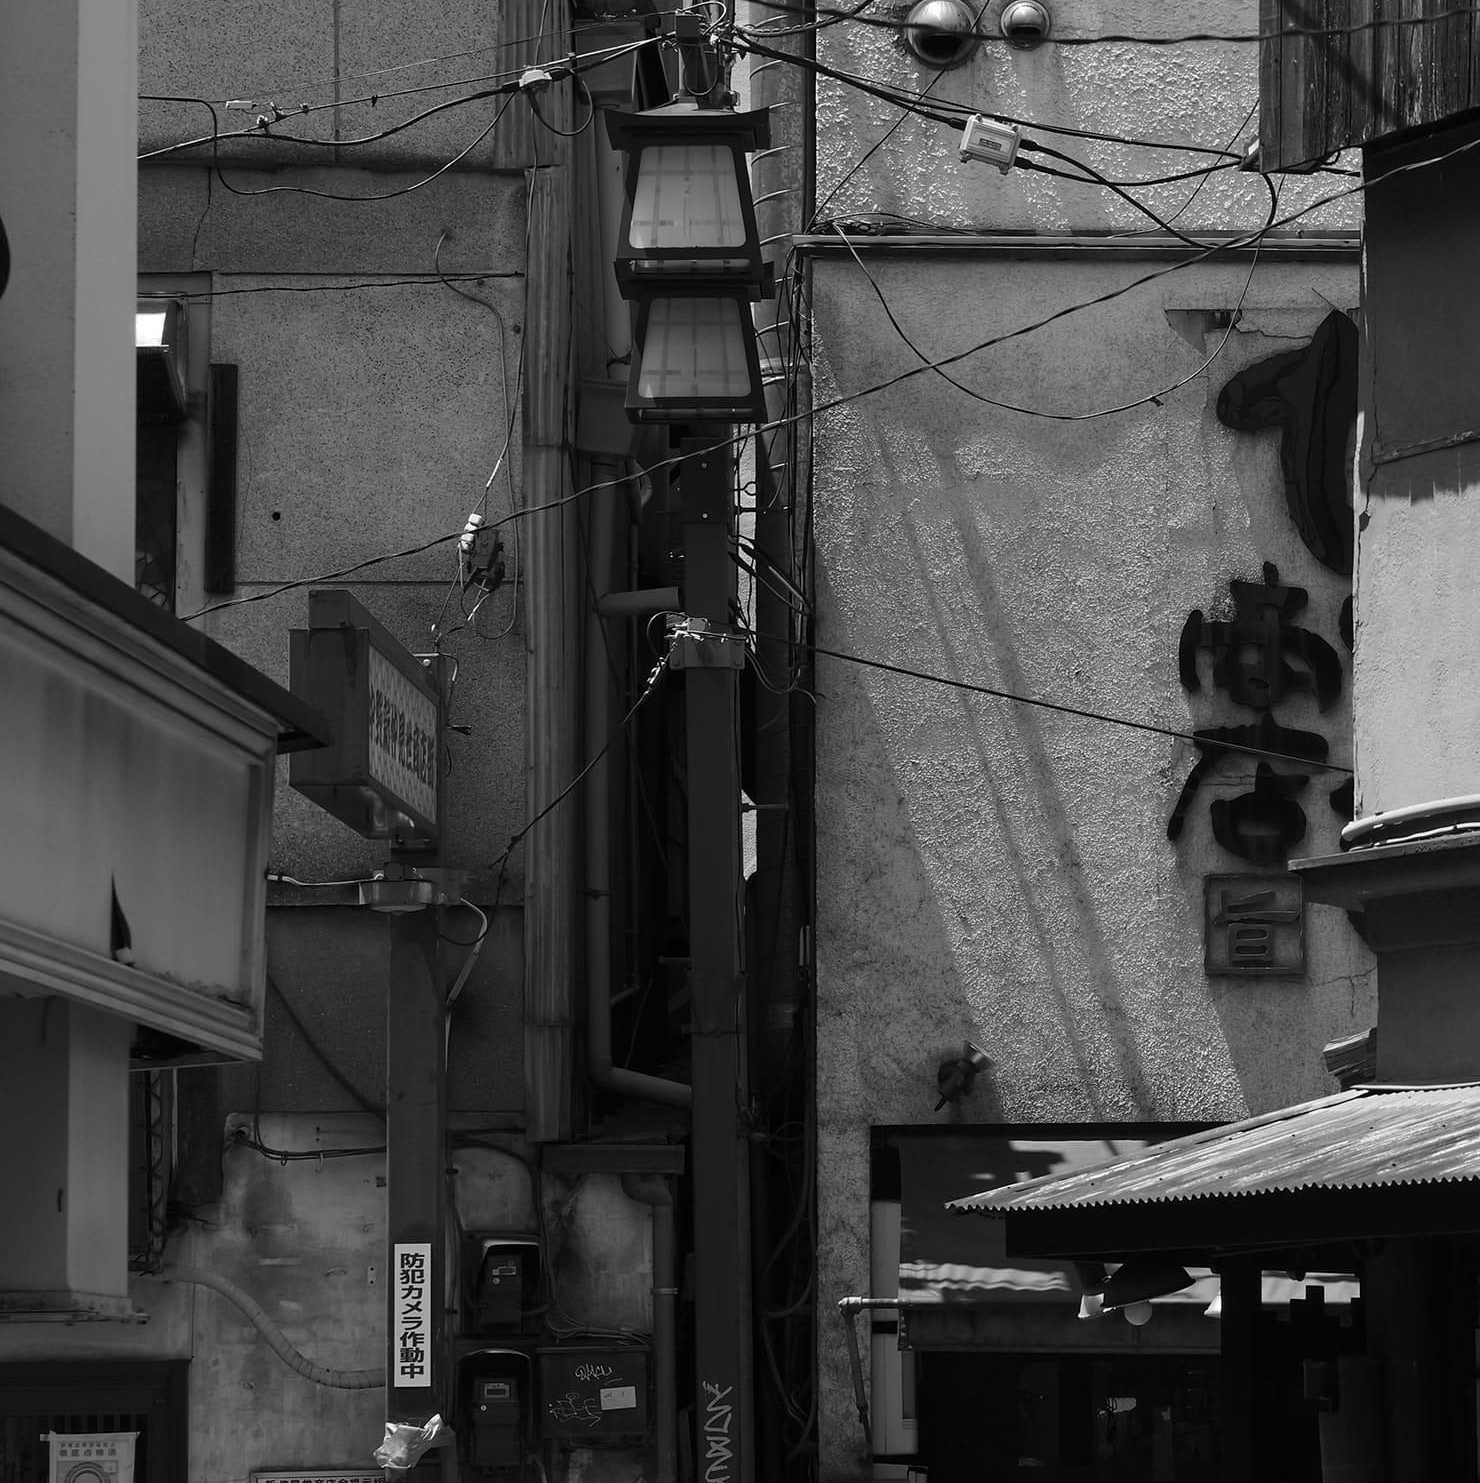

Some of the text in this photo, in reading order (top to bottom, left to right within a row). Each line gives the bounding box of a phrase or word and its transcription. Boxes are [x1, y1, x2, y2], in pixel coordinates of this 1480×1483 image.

[400, 1253, 425, 1379] 防犯カメラ作動中
